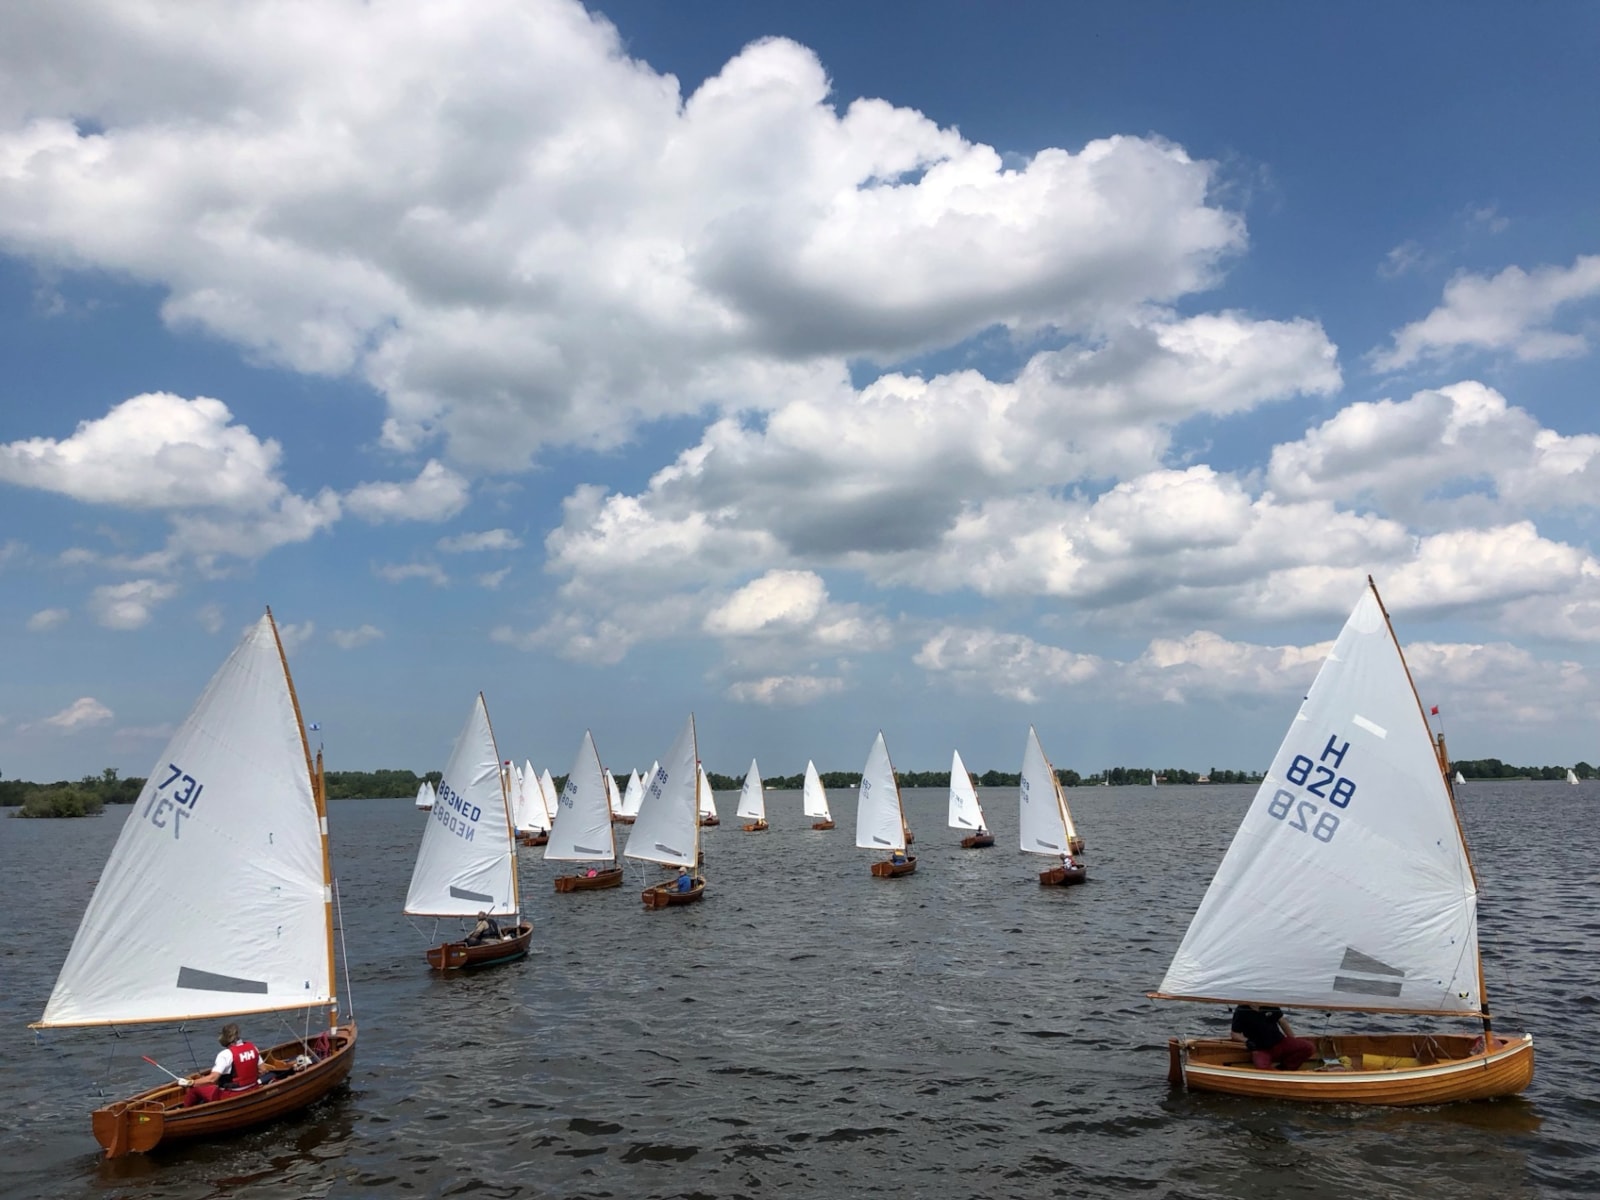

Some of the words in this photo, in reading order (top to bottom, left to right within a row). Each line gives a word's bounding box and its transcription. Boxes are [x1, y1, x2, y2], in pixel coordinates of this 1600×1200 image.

[1320, 734, 1350, 769] H
[158, 763, 203, 809] 731
[1286, 754, 1356, 809] 828
[239, 1049, 255, 1063] HH
